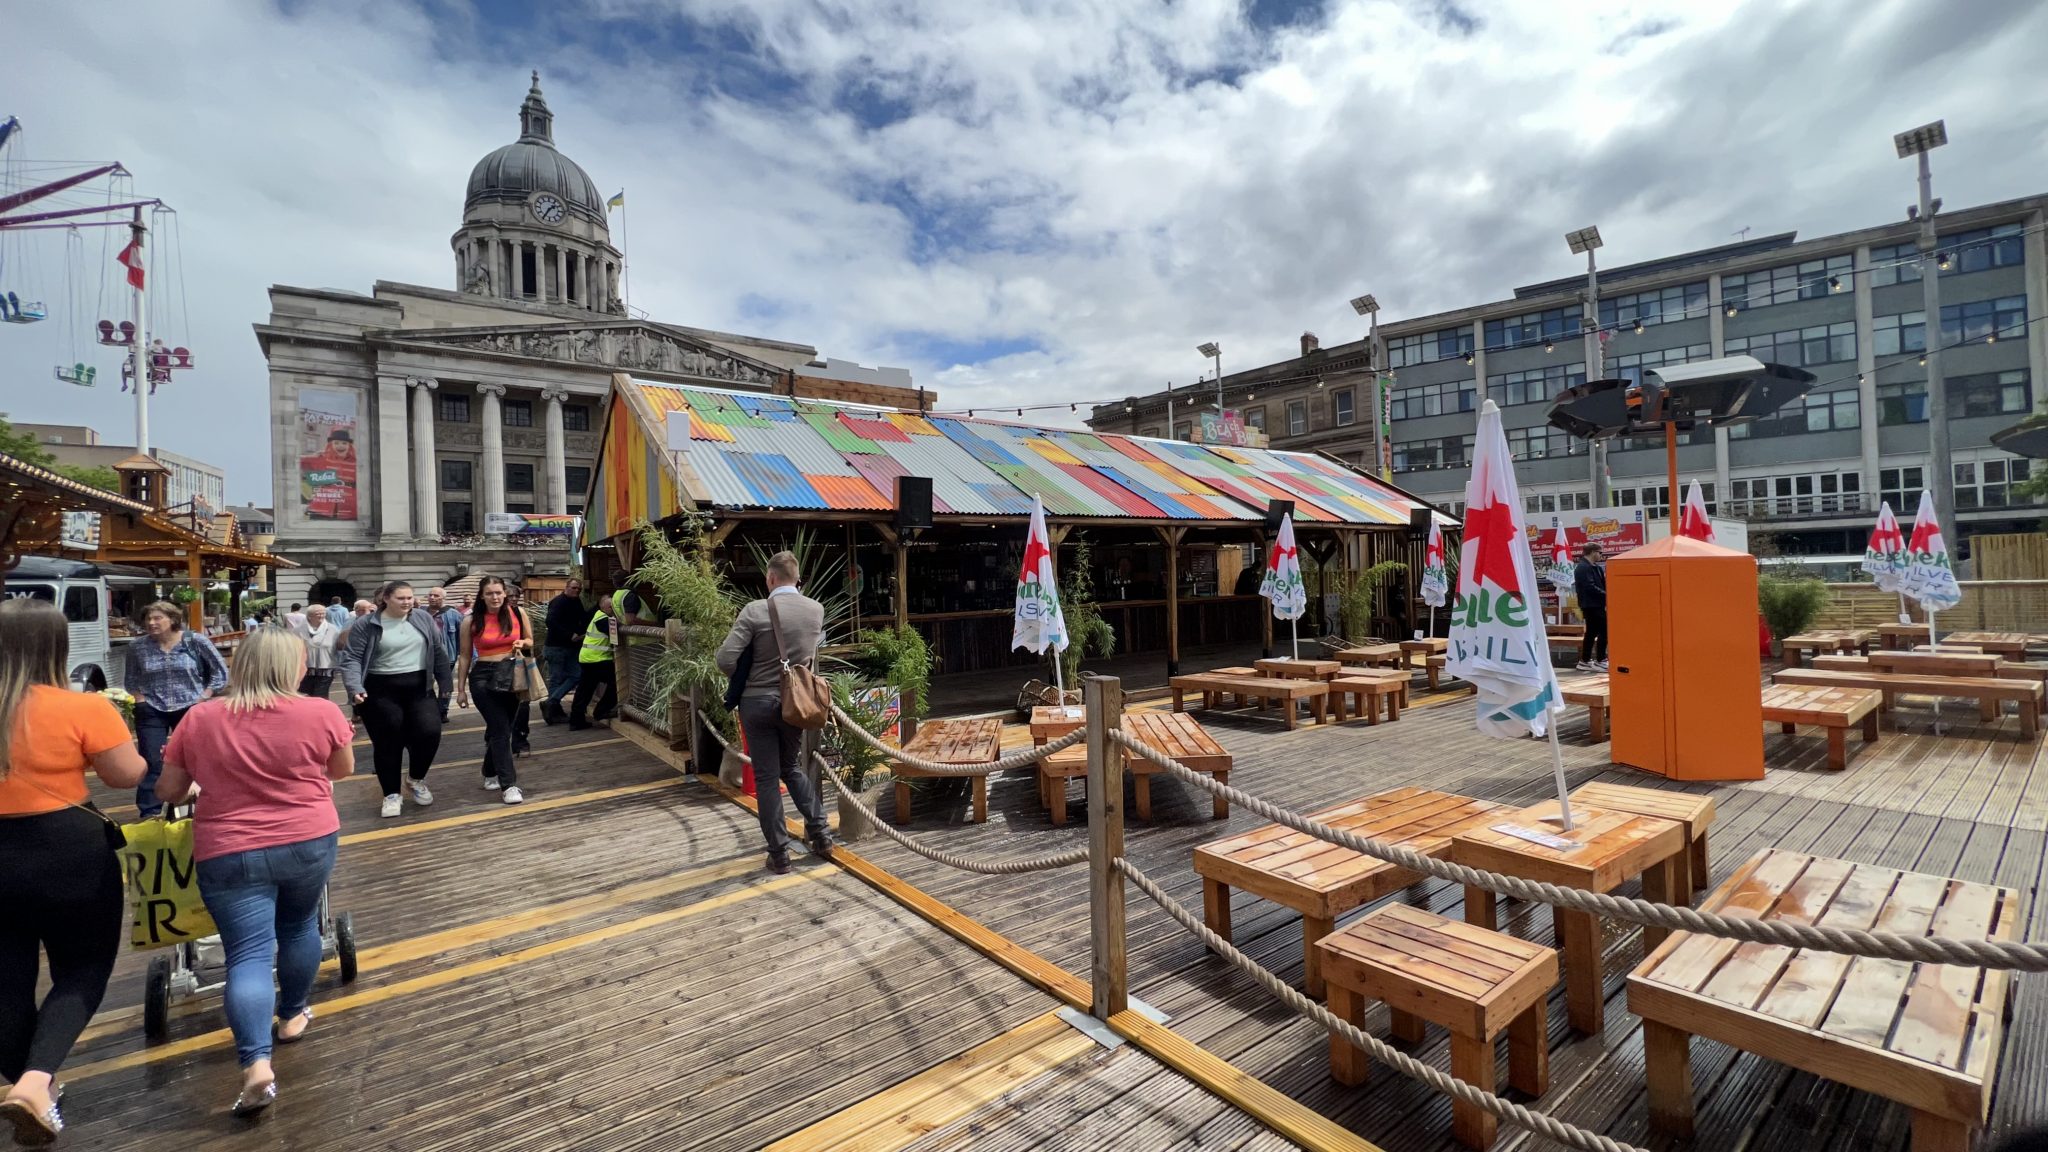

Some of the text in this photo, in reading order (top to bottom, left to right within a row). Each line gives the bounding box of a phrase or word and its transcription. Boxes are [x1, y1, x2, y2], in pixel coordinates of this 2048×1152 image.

[309, 471, 336, 481] Rebel
[538, 518, 572, 529] Love
[1586, 519, 1619, 535] Beach
